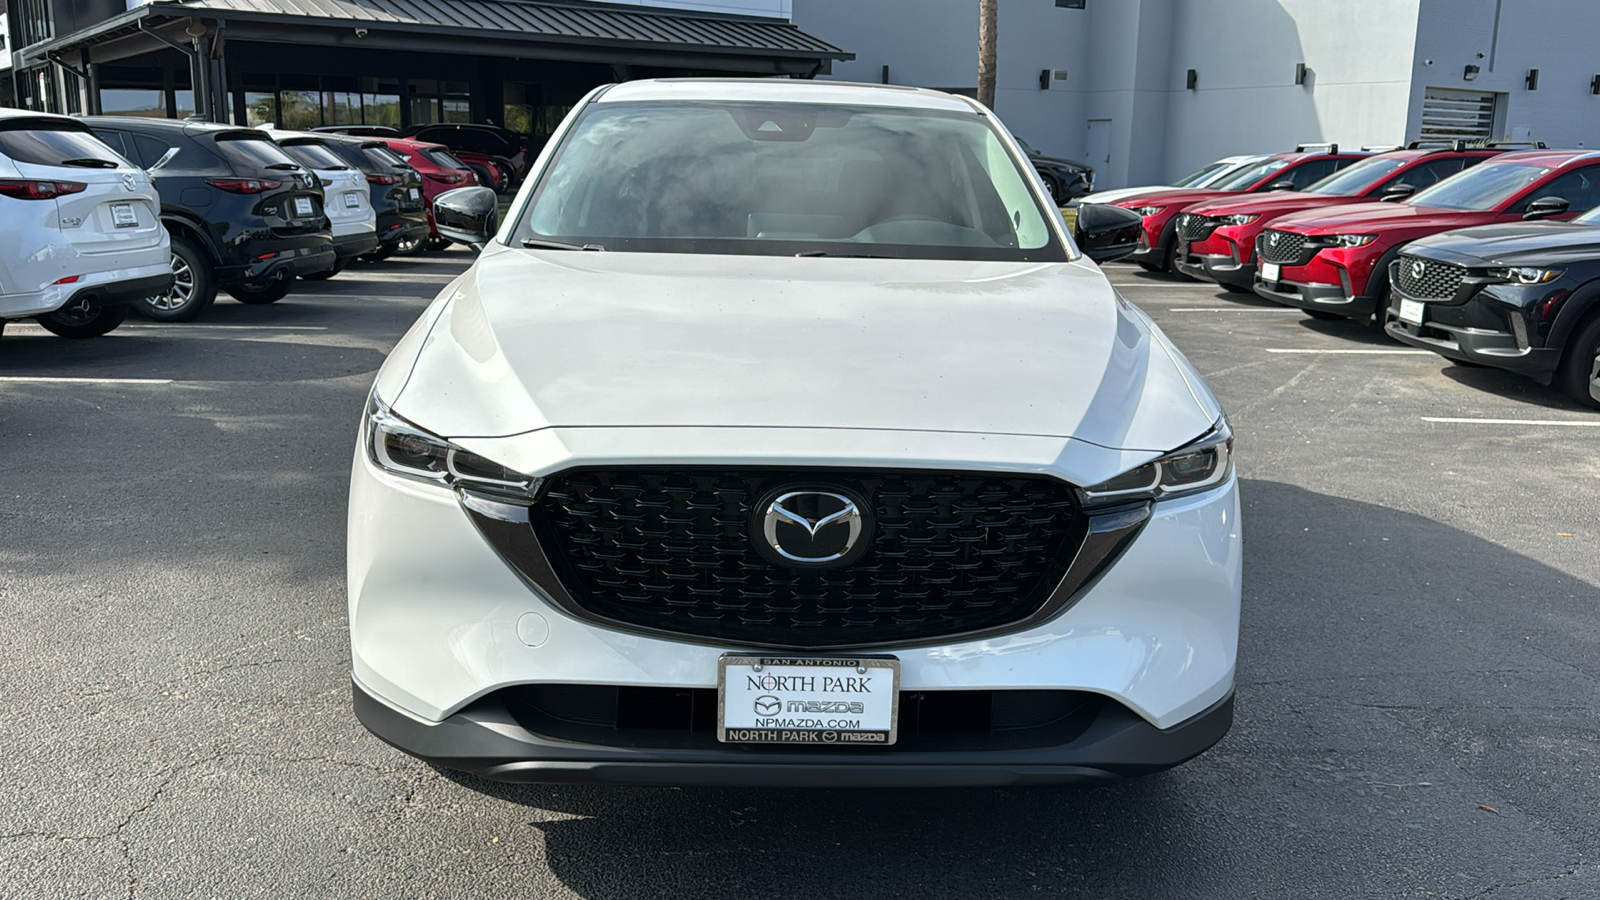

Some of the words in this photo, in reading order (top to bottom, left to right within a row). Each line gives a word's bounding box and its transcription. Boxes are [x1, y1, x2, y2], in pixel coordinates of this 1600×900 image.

[747, 675, 815, 692] NORTH
[822, 676, 872, 693] PARK
[787, 700, 864, 713] mazda
[755, 718, 860, 729] NPMAZDA.COM
[729, 730, 777, 741] NORTH
[781, 731, 819, 741] PARK
[841, 733, 885, 742] mazda
